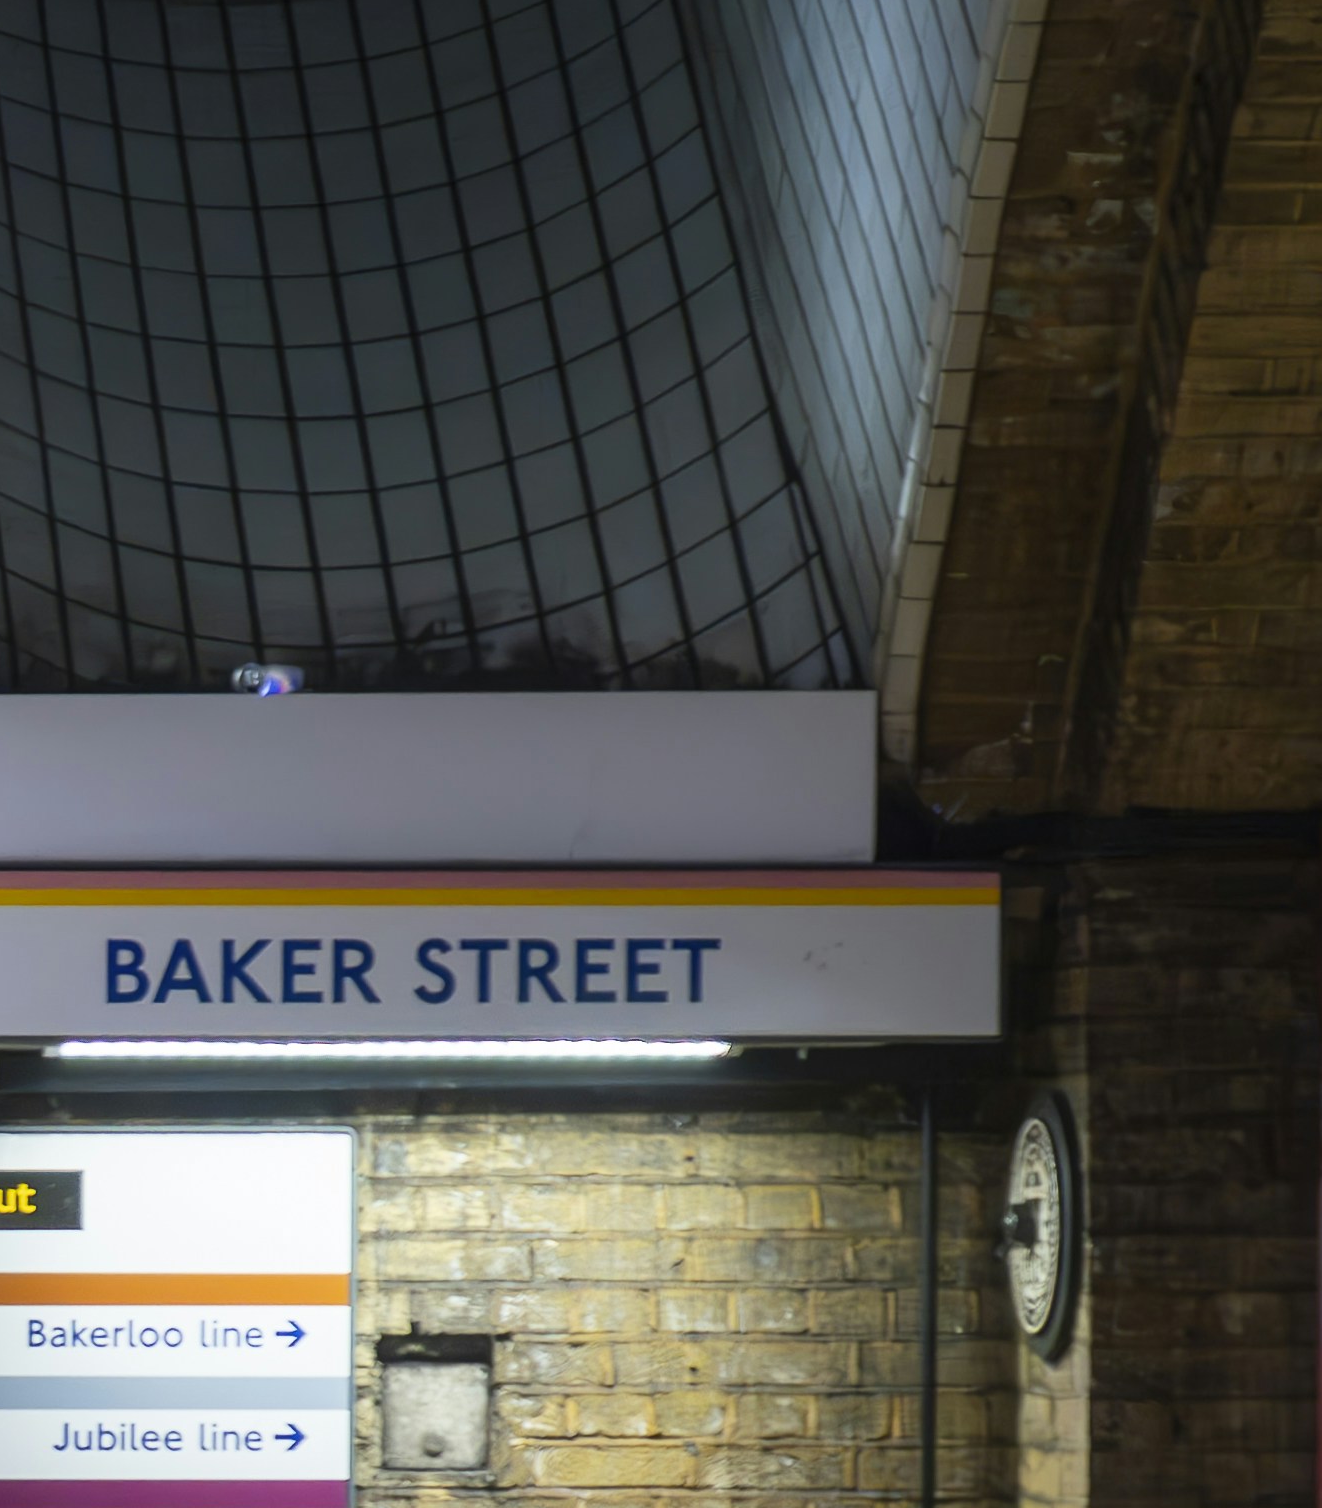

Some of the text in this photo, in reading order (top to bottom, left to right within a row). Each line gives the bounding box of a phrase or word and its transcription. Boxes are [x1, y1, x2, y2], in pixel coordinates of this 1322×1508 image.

[106, 938, 722, 1005] BAKER STREET
[28, 1319, 263, 1348] Bakerloo line
[52, 1422, 262, 1452] Jubilee line
